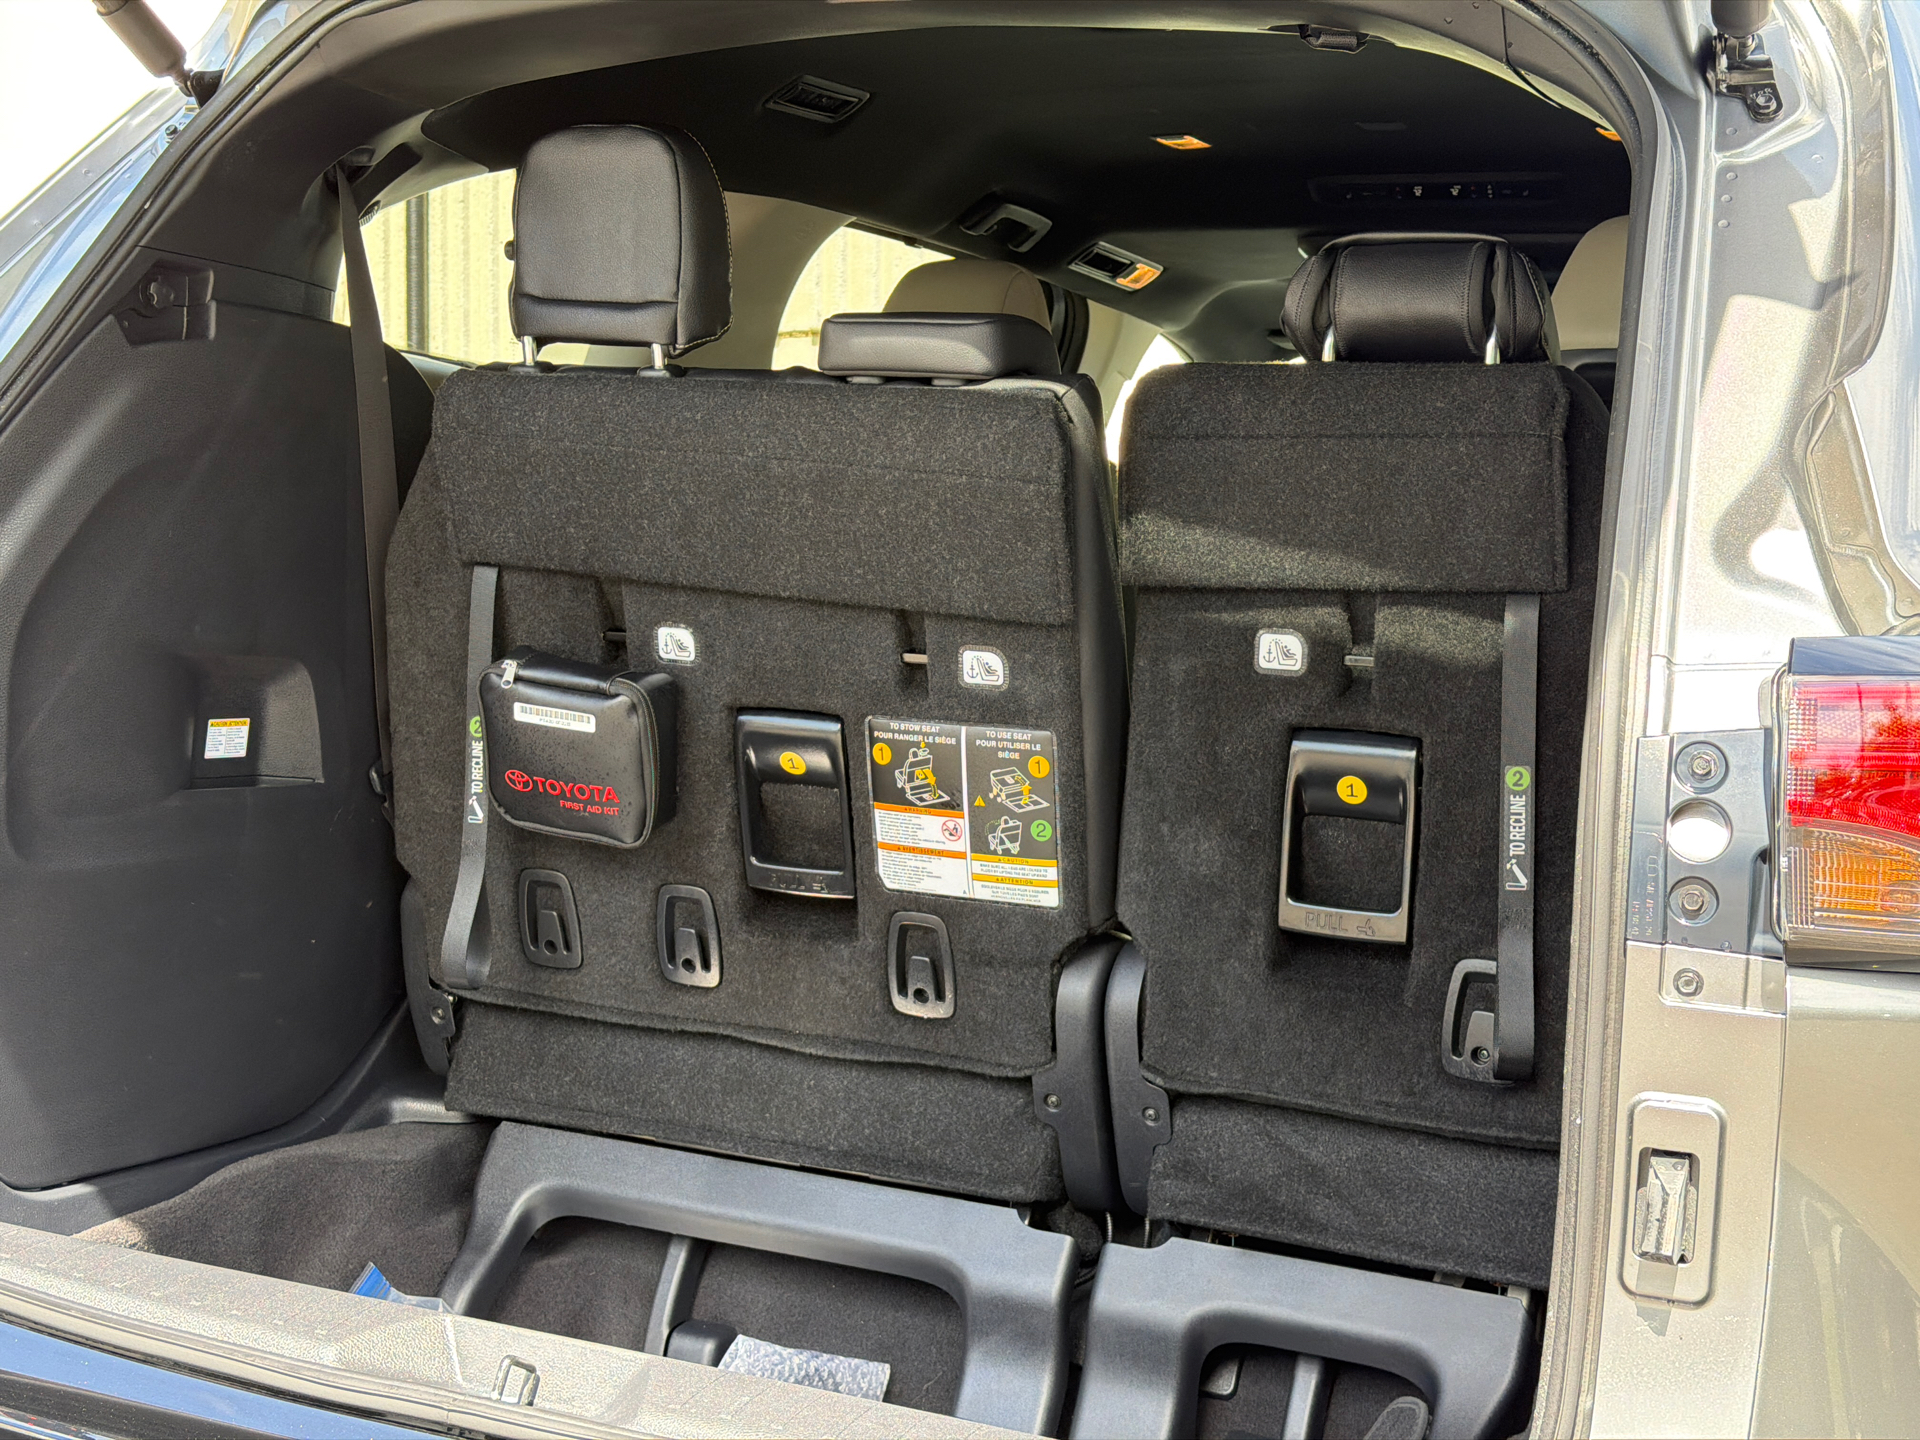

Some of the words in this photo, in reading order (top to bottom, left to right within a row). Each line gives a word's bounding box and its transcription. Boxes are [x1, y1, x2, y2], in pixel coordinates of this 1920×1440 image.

[474, 718, 482, 734] 2
[890, 722, 900, 730] TO
[900, 723, 921, 731] STOW
[921, 725, 940, 733] SEAT
[874, 731, 893, 739] POUR
[894, 733, 923, 742] RANGER
[997, 731, 1012, 739] USE
[1013, 732, 1032, 740] SEAT
[975, 739, 996, 747] POUR
[998, 741, 1031, 750] UTILISER
[471, 740, 484, 780] RECLINE
[786, 757, 800, 770] 1
[1034, 759, 1041, 774] 1
[1512, 769, 1524, 788] 2
[471, 780, 484, 795] TO
[533, 776, 620, 803] TOYOTA
[1345, 783, 1358, 798] 1
[560, 800, 584, 811] FIRST
[586, 804, 602, 814] AID
[604, 807, 619, 816] KIT
[1510, 794, 1525, 840] RECLINE
[1036, 822, 1047, 838] 2
[1510, 842, 1525, 857] TO
[1000, 877, 1034, 885] ATTENTION
[1304, 911, 1348, 932] PULL
